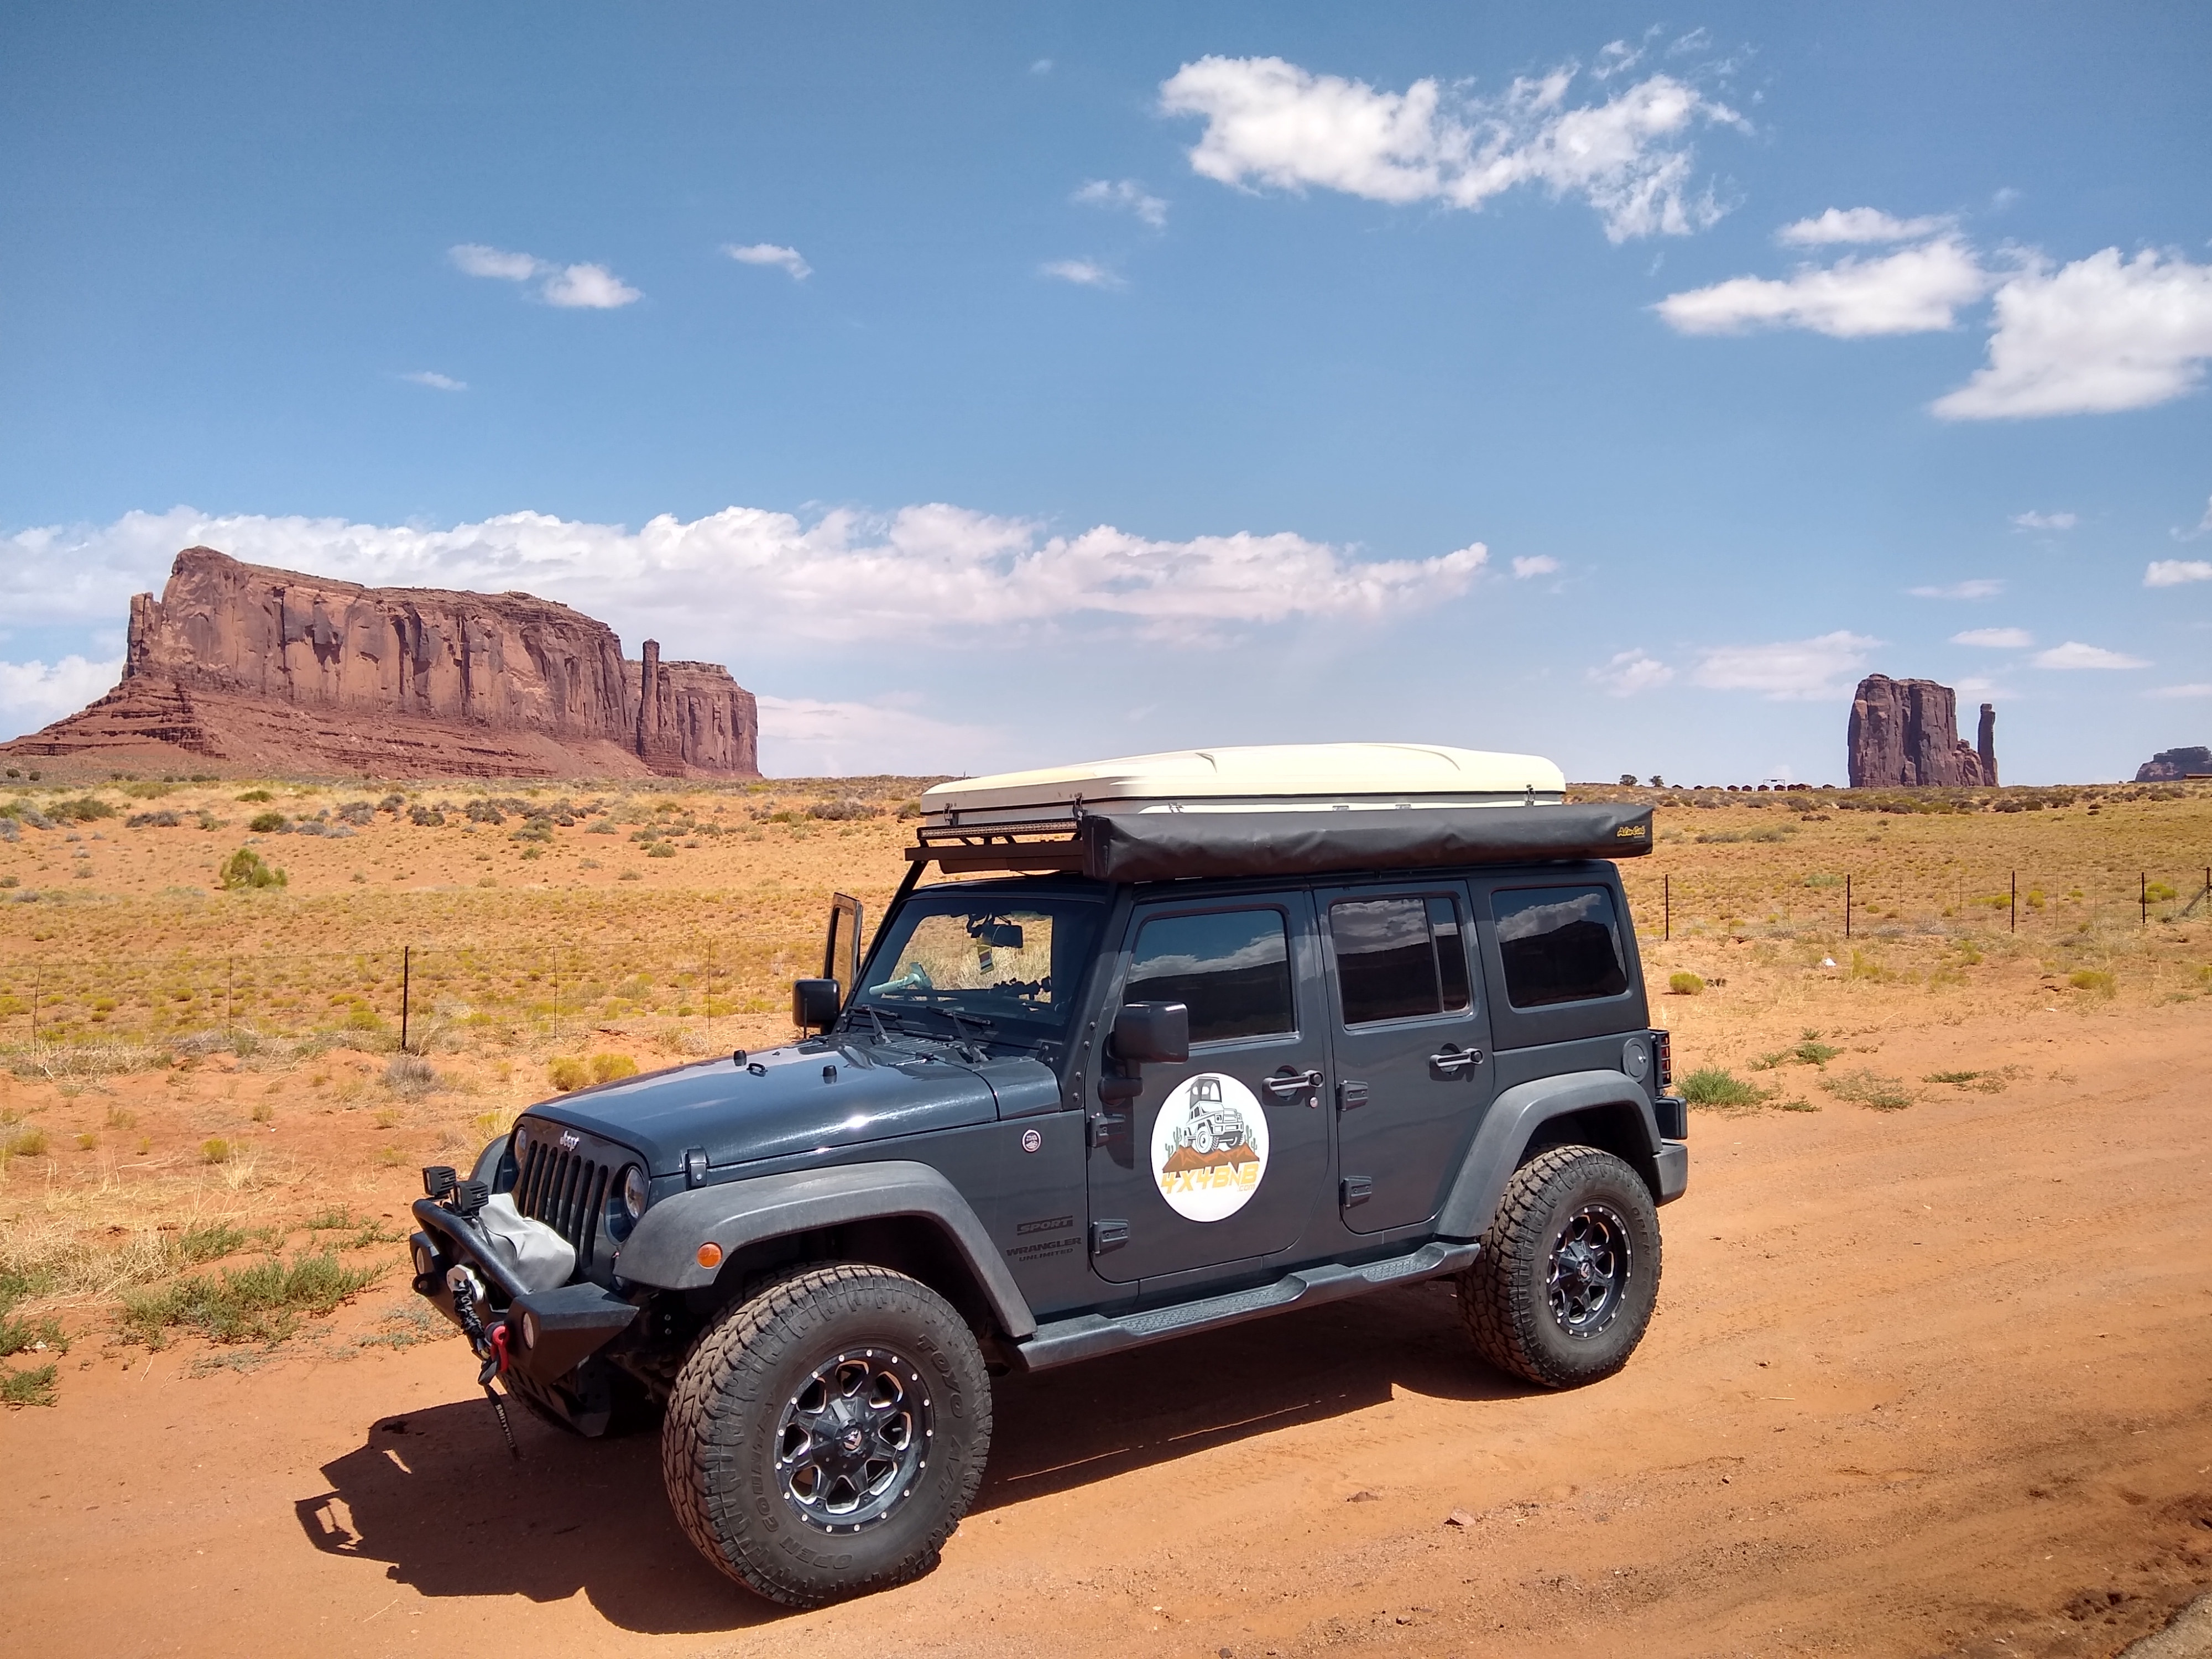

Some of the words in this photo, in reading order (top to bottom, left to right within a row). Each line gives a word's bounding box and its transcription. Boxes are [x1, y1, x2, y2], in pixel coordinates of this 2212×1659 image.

[1019, 1218, 1070, 1232] SPORT
[1006, 1237, 1082, 1256] WRANGLER
[1019, 1248, 1073, 1261] UNLIMITED
[917, 1334, 963, 1418] TOYO
[779, 1536, 853, 1570] OPEN
